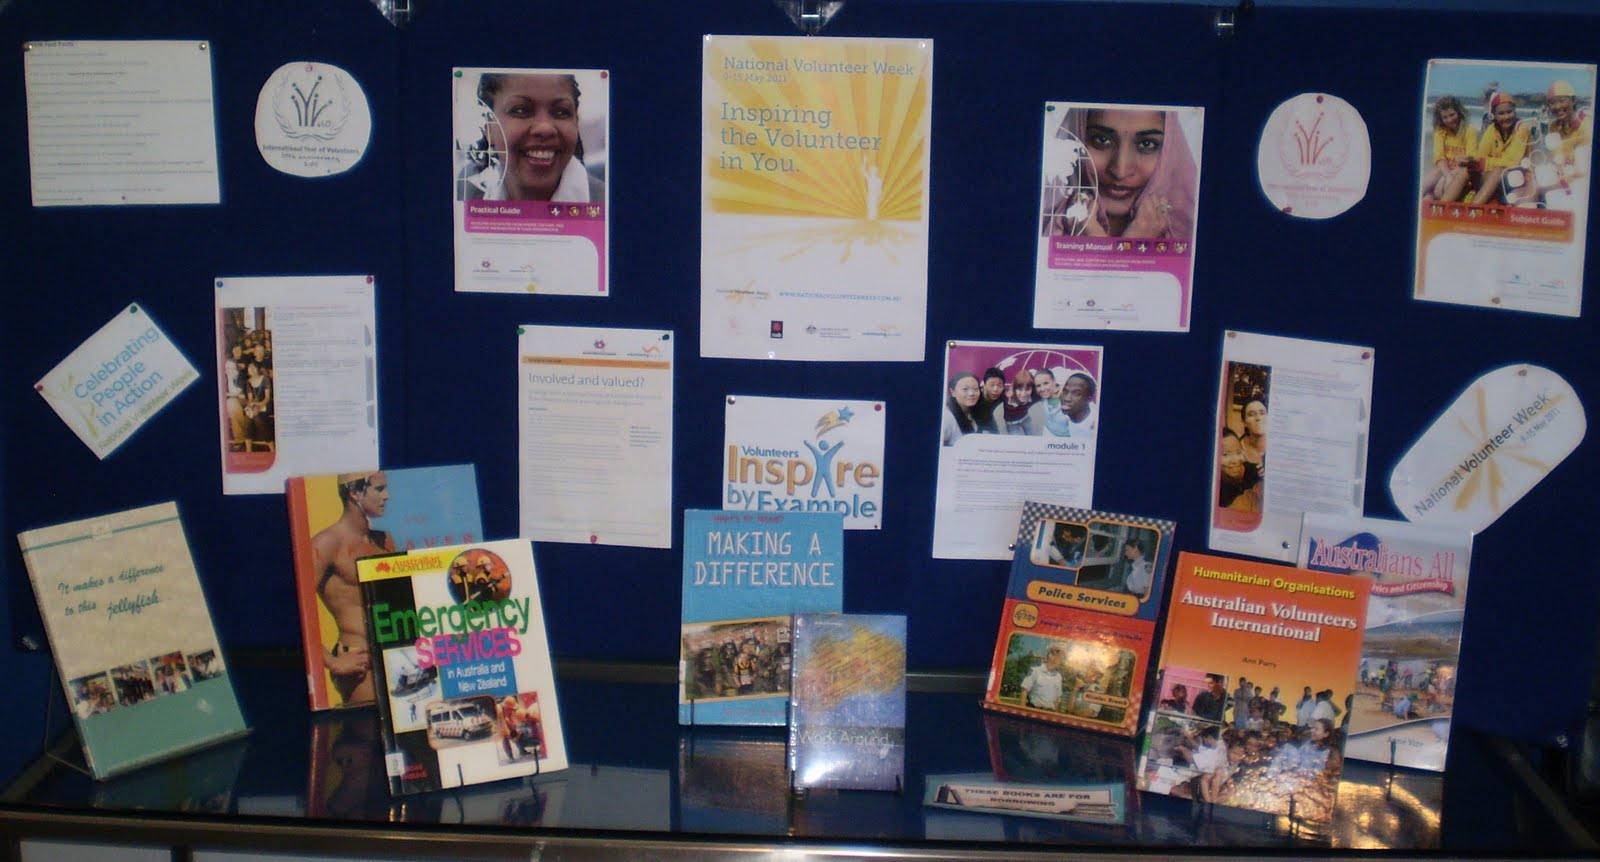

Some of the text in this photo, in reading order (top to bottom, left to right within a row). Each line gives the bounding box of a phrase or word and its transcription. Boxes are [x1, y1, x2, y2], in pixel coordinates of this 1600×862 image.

[724, 57, 914, 76] National Volunteer Week
[746, 74, 763, 84] May
[766, 75, 787, 83] 2011
[721, 102, 832, 128] Inspiring
[721, 127, 882, 151] the Volunteer
[719, 152, 800, 173] in You.
[470, 206, 521, 215] Practical Guide
[1510, 214, 1566, 226] Subject Guide
[1056, 242, 1113, 252] Training Manual
[74, 326, 161, 401] Celebrating
[92, 361, 145, 407] People
[529, 373, 645, 388] Involved and valued?
[96, 371, 163, 427] in Action
[742, 445, 800, 458] Volunteers
[1414, 393, 1551, 516] National Volunteer Week
[727, 484, 877, 518] by Example
[708, 532, 822, 555] MAKING A
[392, 556, 441, 569] Australian
[1311, 537, 1456, 581] Australians All
[58, 564, 165, 595] It makes a difference
[694, 561, 835, 587] DIFFERENCE
[1194, 566, 1356, 599] Humanitarian Organisations
[1038, 585, 1127, 609] Police Services
[1390, 584, 1405, 593] and
[1406, 580, 1448, 591] Citizenship
[65, 589, 161, 621] to this jellyfish
[1181, 590, 1357, 630] Australian Volunteers
[371, 596, 530, 644] Emergency
[1211, 613, 1321, 642] International
[415, 626, 522, 669] SERVICES
[447, 661, 506, 679] in Australia and
[1242, 656, 1257, 665] Ann
[458, 676, 507, 693] New Zealand
[798, 731, 889, 746] Work Around
[965, 788, 1091, 801] THESE BOOKS ARE FOR
[990, 797, 1056, 807] BORROWING
